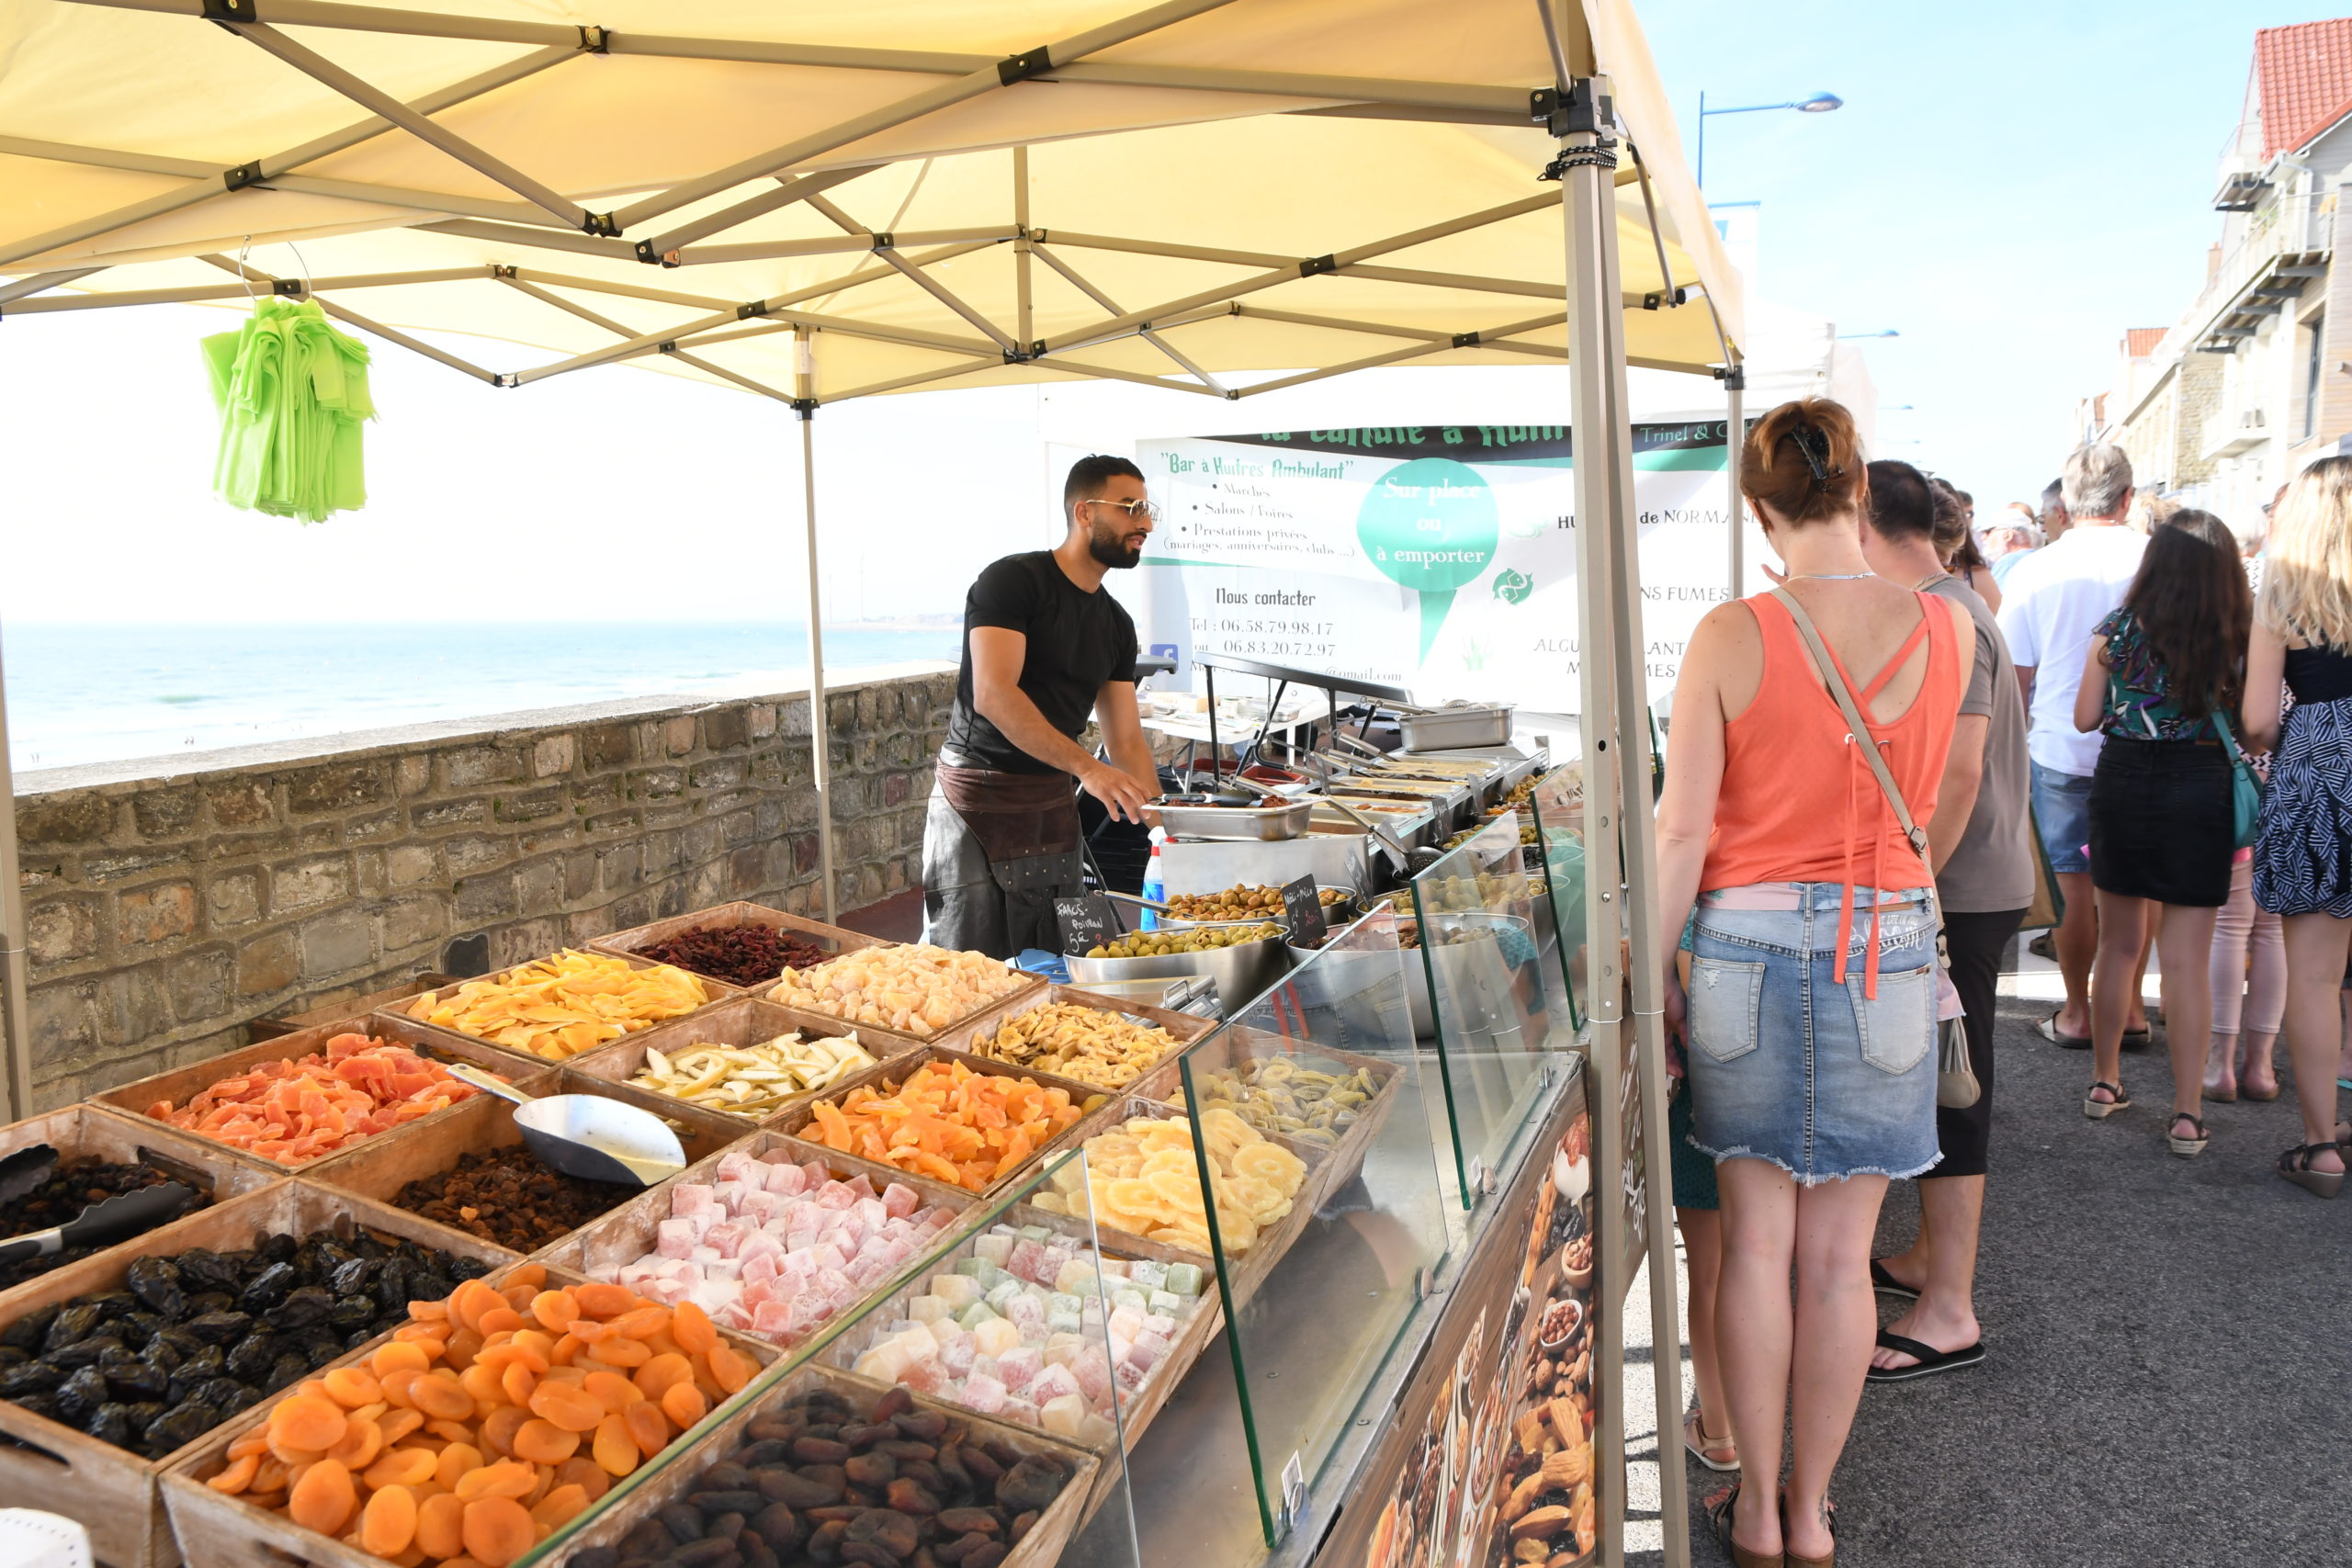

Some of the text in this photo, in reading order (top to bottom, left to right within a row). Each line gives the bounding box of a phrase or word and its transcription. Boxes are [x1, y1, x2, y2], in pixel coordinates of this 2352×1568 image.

[1640, 425, 1688, 443] Trinel
[1694, 423, 1711, 440] &
[1202, 459, 1209, 473] à
[1224, 482, 1271, 497] Marchés
[1383, 476, 1481, 506] Sur place
[1204, 502, 1245, 515] Salons
[1257, 505, 1294, 519] Foires
[1639, 511, 1659, 525] de
[1417, 517, 1441, 531] ou
[1194, 523, 1308, 547] Prestations privées
[1306, 543, 1336, 555] clubs
[1376, 546, 1485, 570] à emporter
[1216, 588, 1316, 606] Nous contacter
[1668, 586, 1730, 602] FUMES
[1189, 617, 1206, 632] Tel
[1221, 618, 1334, 636] 06.58.79.98.17
[1194, 639, 1336, 657] ou 06.83.20.72.97
